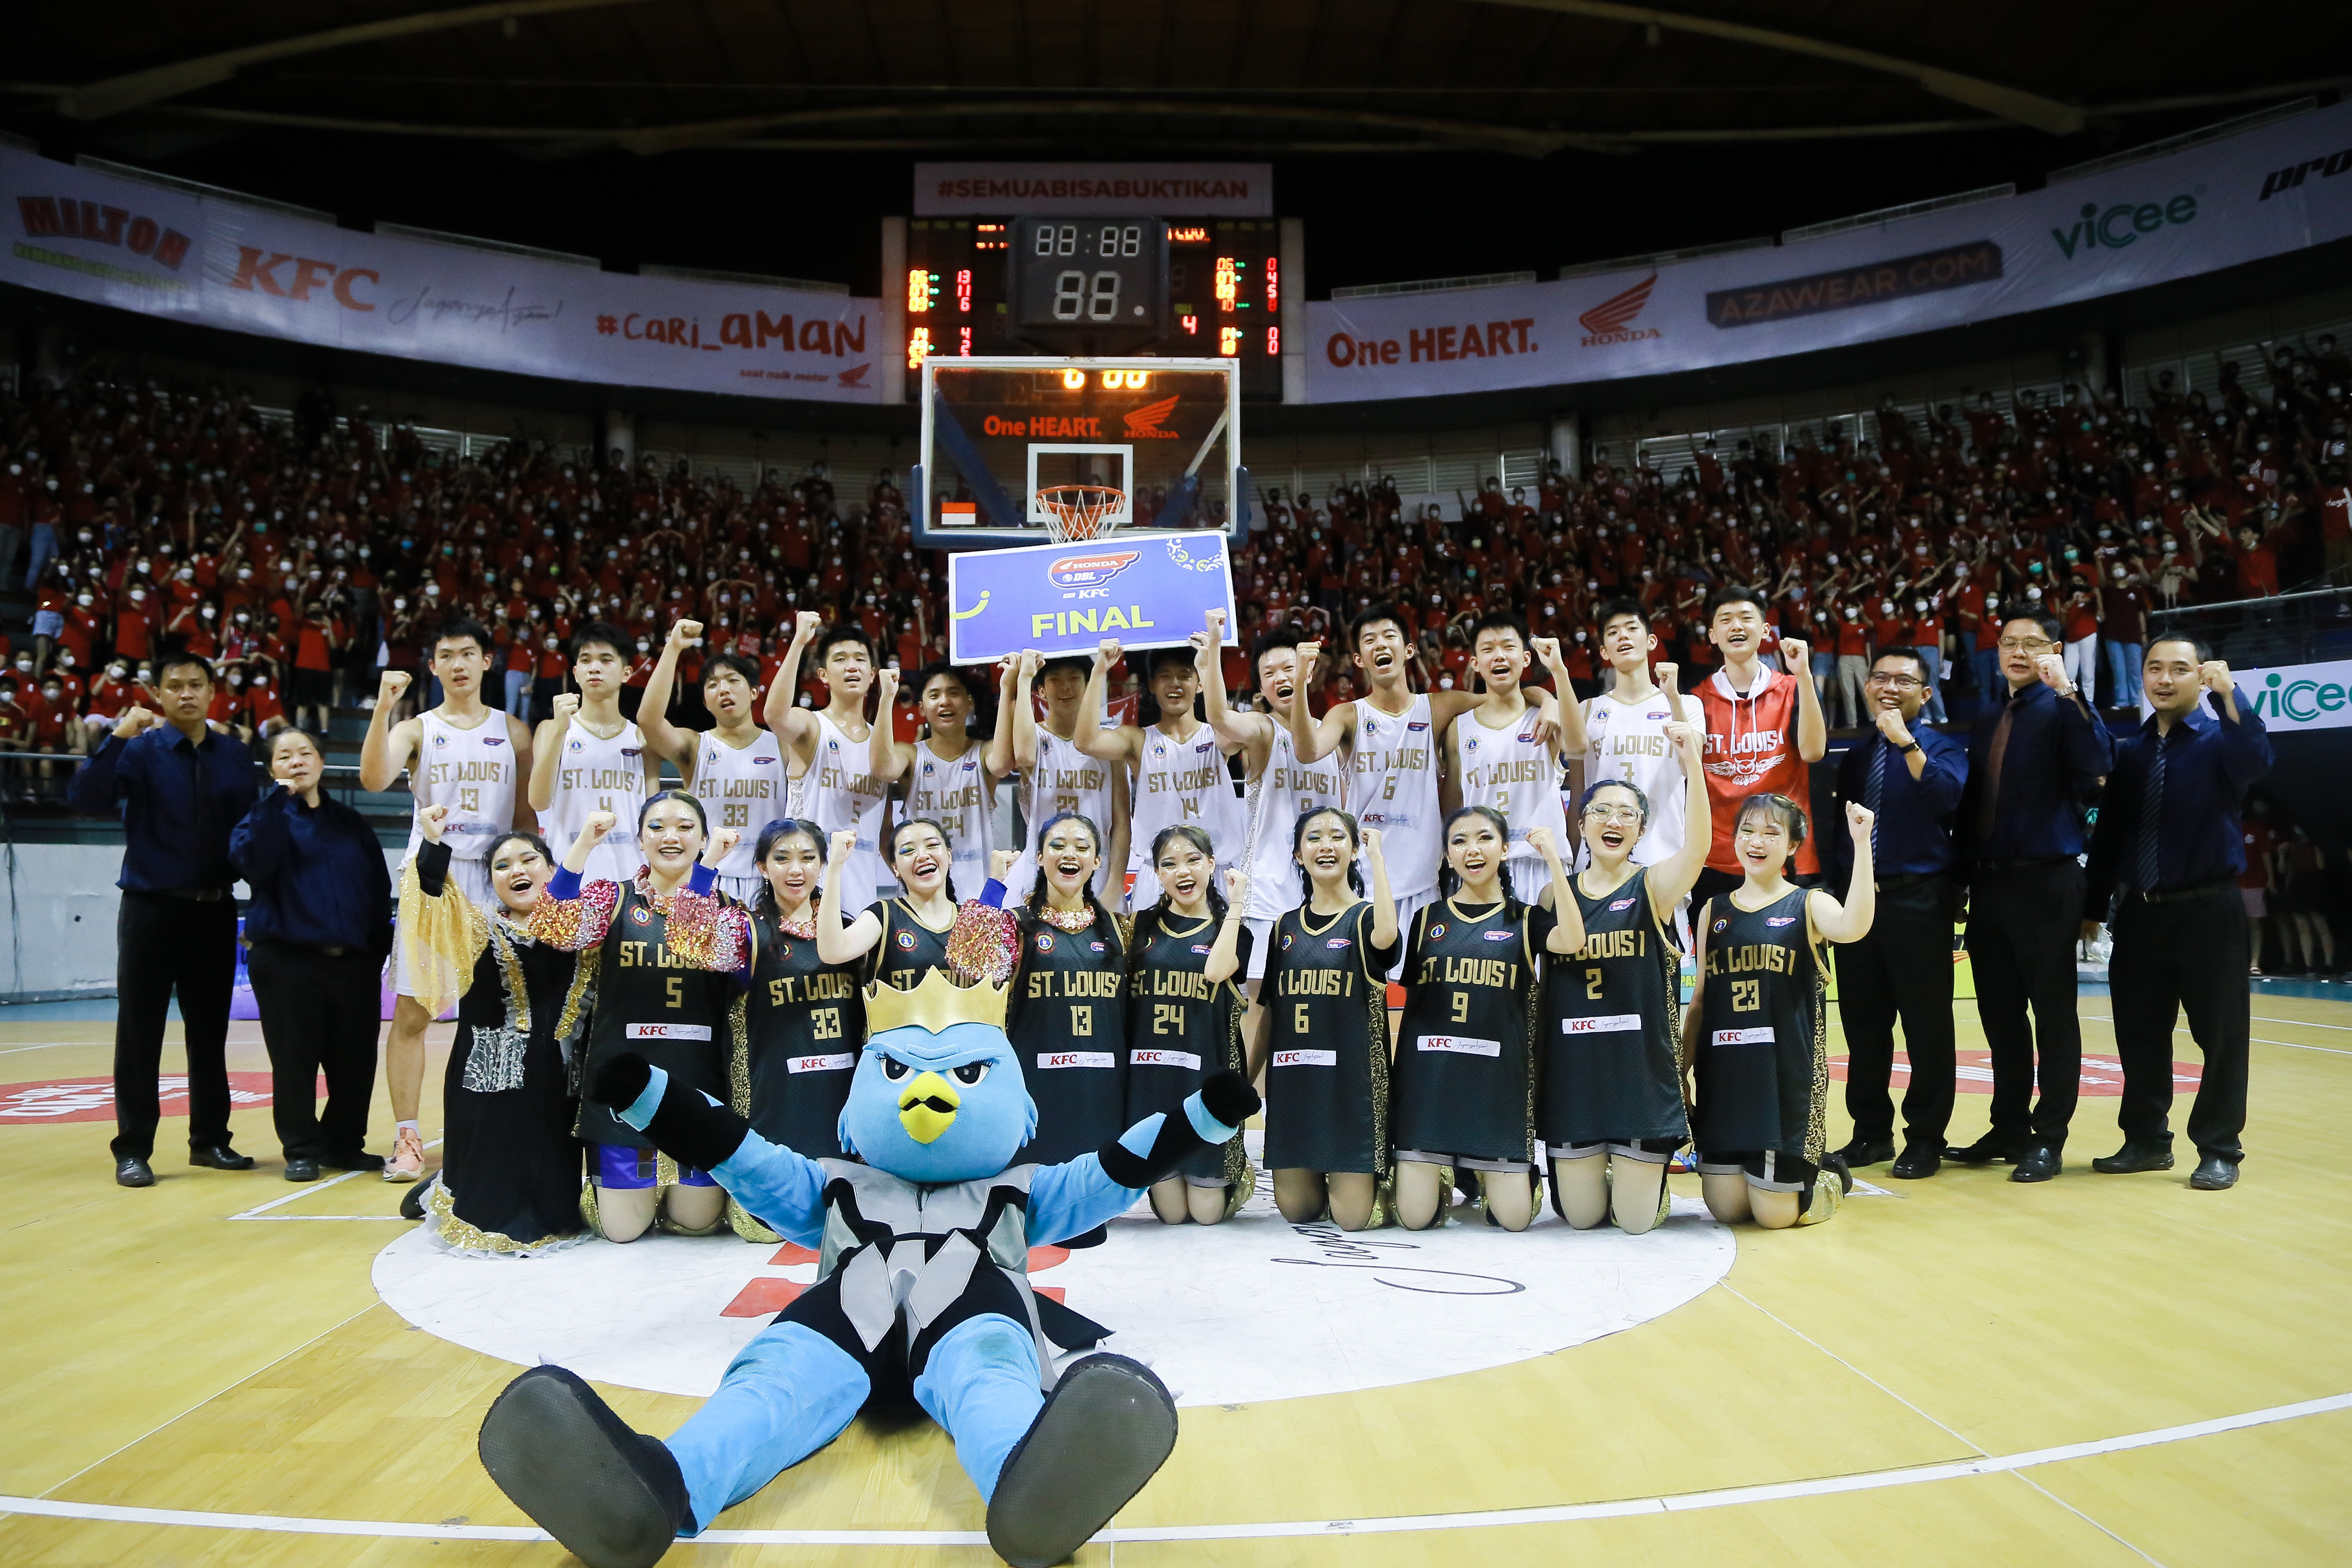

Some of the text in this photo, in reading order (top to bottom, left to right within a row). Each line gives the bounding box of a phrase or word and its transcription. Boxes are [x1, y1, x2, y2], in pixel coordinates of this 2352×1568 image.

[937, 180, 1248, 199] #SEMUABISABUKTIKAN
[17, 196, 191, 270] MILTON
[1267, 257, 1277, 271] 0
[229, 246, 380, 312] KFC
[957, 270, 971, 284] 13
[1267, 271, 1277, 284] 4
[1718, 249, 1991, 324] AZAWEAR.COM
[1267, 284, 1277, 298] 5
[960, 297, 971, 312] 6
[960, 327, 971, 340] 4
[1183, 315, 1197, 334] 4
[1268, 326, 1278, 340] 0
[1268, 340, 1278, 355] 0
[1326, 318, 1539, 367] One HEART.
[1581, 328, 1662, 347] HONDA
[984, 416, 1102, 437] One HEART.
[1123, 429, 1180, 438] HONDA
[1073, 560, 1119, 569] HONDA
[1073, 572, 1096, 581] DBL
[1078, 588, 1110, 599] KFC
[1032, 605, 1155, 638] FINAL
[1614, 735, 1664, 755] LOUIS
[1705, 733, 1728, 754] ST.
[1732, 729, 1777, 754] LOUIS
[1356, 751, 1380, 773] ST.
[1386, 749, 1423, 771] LOUIS
[1488, 760, 1536, 784] LOUIS
[1540, 760, 1546, 781] 1
[430, 762, 453, 784] ST.
[458, 761, 500, 782] LOUIS
[562, 768, 586, 790] ST.
[822, 767, 842, 789] ST.
[1056, 769, 1097, 790] LOUIS
[1148, 766, 1222, 793] ST. LOUIS 1
[698, 778, 719, 799] ST.
[724, 778, 770, 799] LOUIS
[1332, 775, 1337, 796] 1
[1383, 776, 1396, 799] 6
[461, 788, 479, 811] 13
[600, 796, 611, 812] 4
[940, 786, 980, 809] LOUIS
[1057, 796, 1079, 814] 23
[1182, 796, 1199, 820] 14
[1496, 791, 1509, 815] 2
[723, 804, 748, 827] 33
[942, 815, 964, 838] 24
[1364, 814, 1385, 822] KFC
[620, 941, 652, 967] ST.
[1639, 930, 1645, 957] 1
[1728, 944, 1785, 974] LOUIS
[1788, 949, 1796, 976] 1
[1028, 970, 1059, 998] ST.
[1064, 970, 1115, 998] LOUIS
[1288, 969, 1341, 995] LOUIS
[1345, 972, 1354, 997] 1
[1445, 956, 1506, 987] LOUIS
[1510, 964, 1517, 990] 1
[1585, 968, 1602, 1000] 2
[666, 977, 682, 1008] 5
[768, 976, 802, 1007] ST.
[1154, 969, 1208, 1000] LOUIS
[1731, 979, 1760, 1012] 23
[1451, 991, 1469, 1022] 9
[810, 1007, 842, 1040] 33
[1070, 1005, 1092, 1036] 13
[1153, 1004, 1185, 1036] 24
[1295, 1003, 1309, 1033] 6
[1572, 1020, 1595, 1031] KFC
[639, 1026, 667, 1035] KFC
[1719, 1032, 1742, 1042] KFC
[1428, 1038, 1452, 1048] KFC
[802, 1058, 826, 1069] KFC
[1050, 1054, 1077, 1065] KFC
[1136, 1052, 1162, 1061] KFC
[1277, 1053, 1300, 1063] KFC
